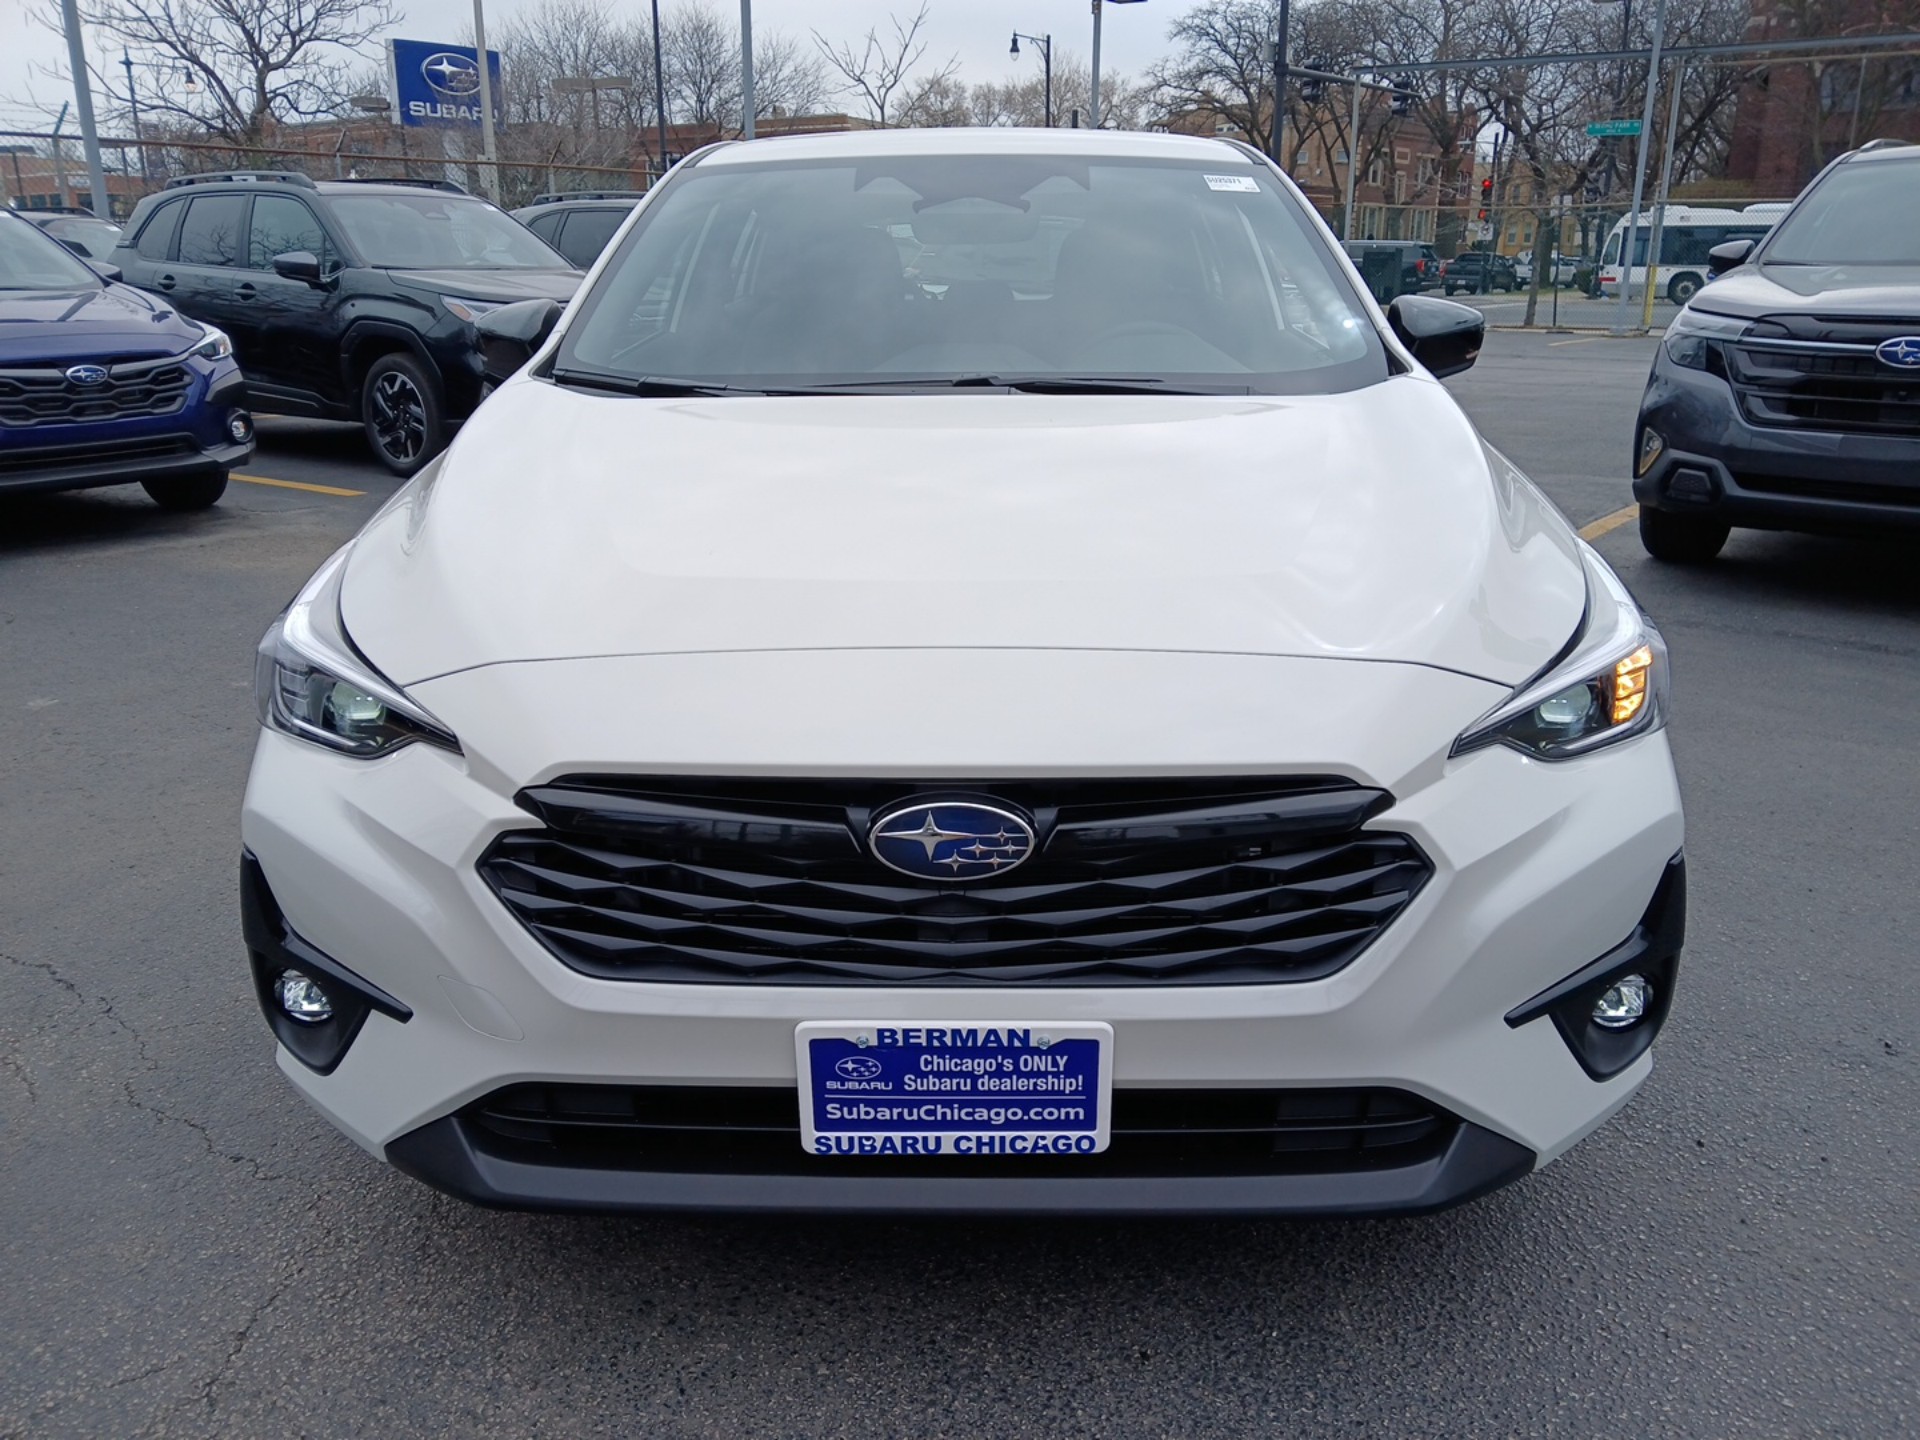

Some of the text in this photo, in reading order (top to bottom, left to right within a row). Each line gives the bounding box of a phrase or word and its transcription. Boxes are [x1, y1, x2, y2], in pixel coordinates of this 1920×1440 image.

[876, 1028, 1031, 1047] BERMAN
[920, 1054, 1068, 1074] Chicago's ONLY
[826, 1081, 892, 1090] SUBARU
[904, 1074, 1083, 1094] Subaru dealership!
[826, 1104, 1085, 1124] SubaruChicago.com
[814, 1135, 1096, 1155] SUBARU CHICAGO
